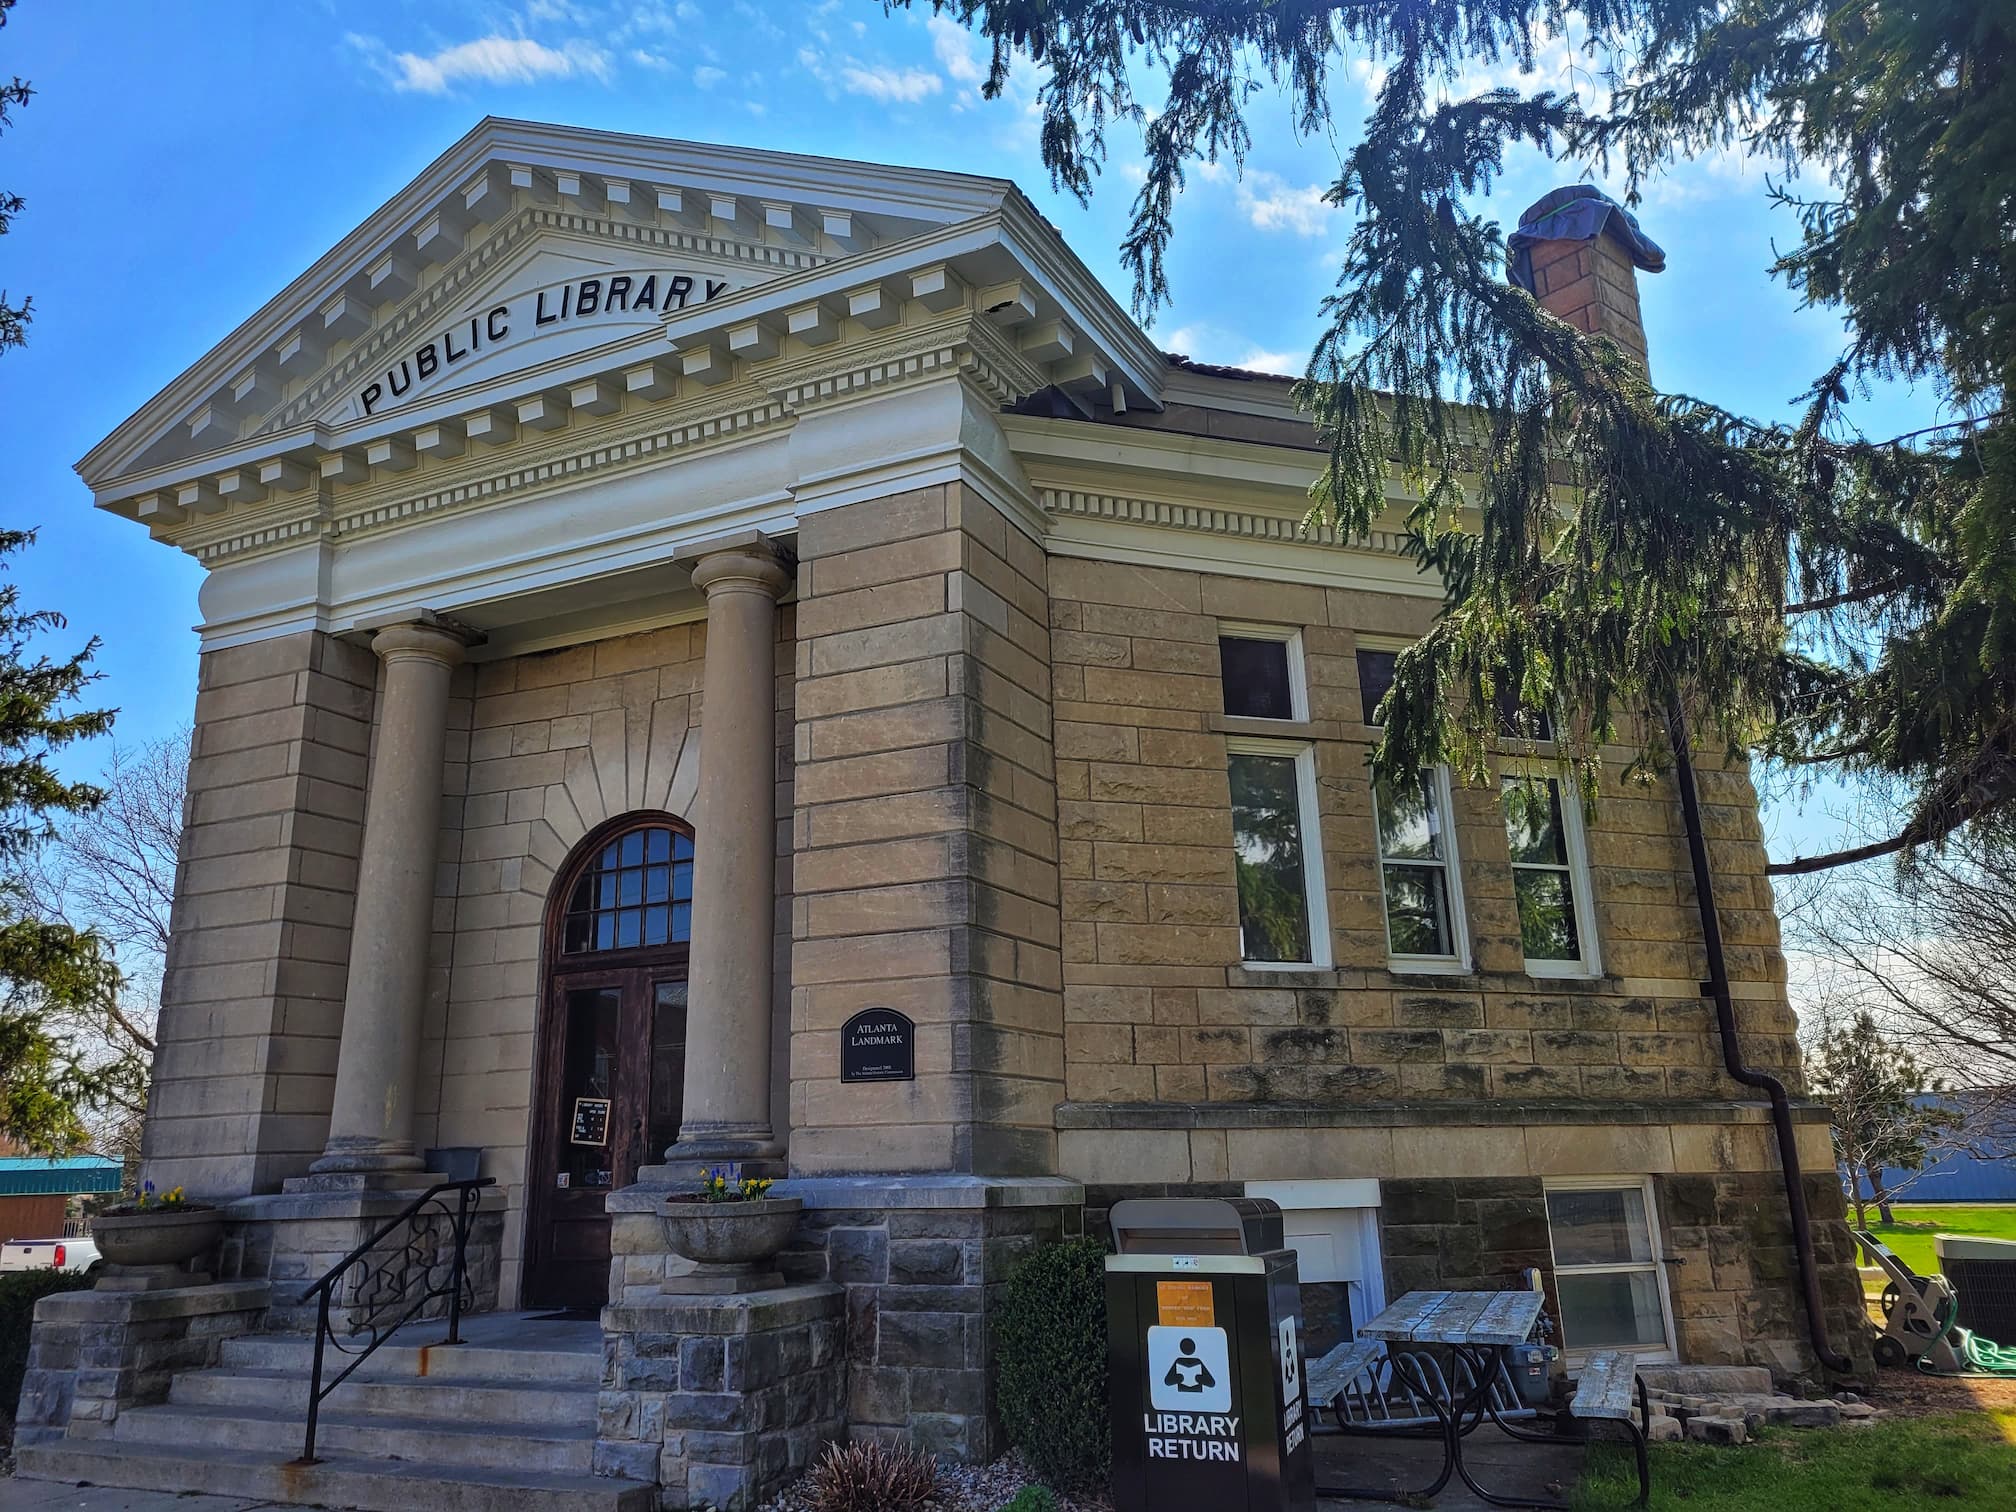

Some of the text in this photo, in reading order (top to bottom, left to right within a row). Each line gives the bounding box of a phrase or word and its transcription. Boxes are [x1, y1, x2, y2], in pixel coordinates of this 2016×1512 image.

[360, 275, 728, 415] PUBLIC LIBRARY
[857, 1023, 898, 1034] ATLANTA
[851, 1035, 903, 1047] LANDMARK
[1144, 1413, 1240, 1437] LIBRARY
[1149, 1438, 1240, 1462] RETURN
